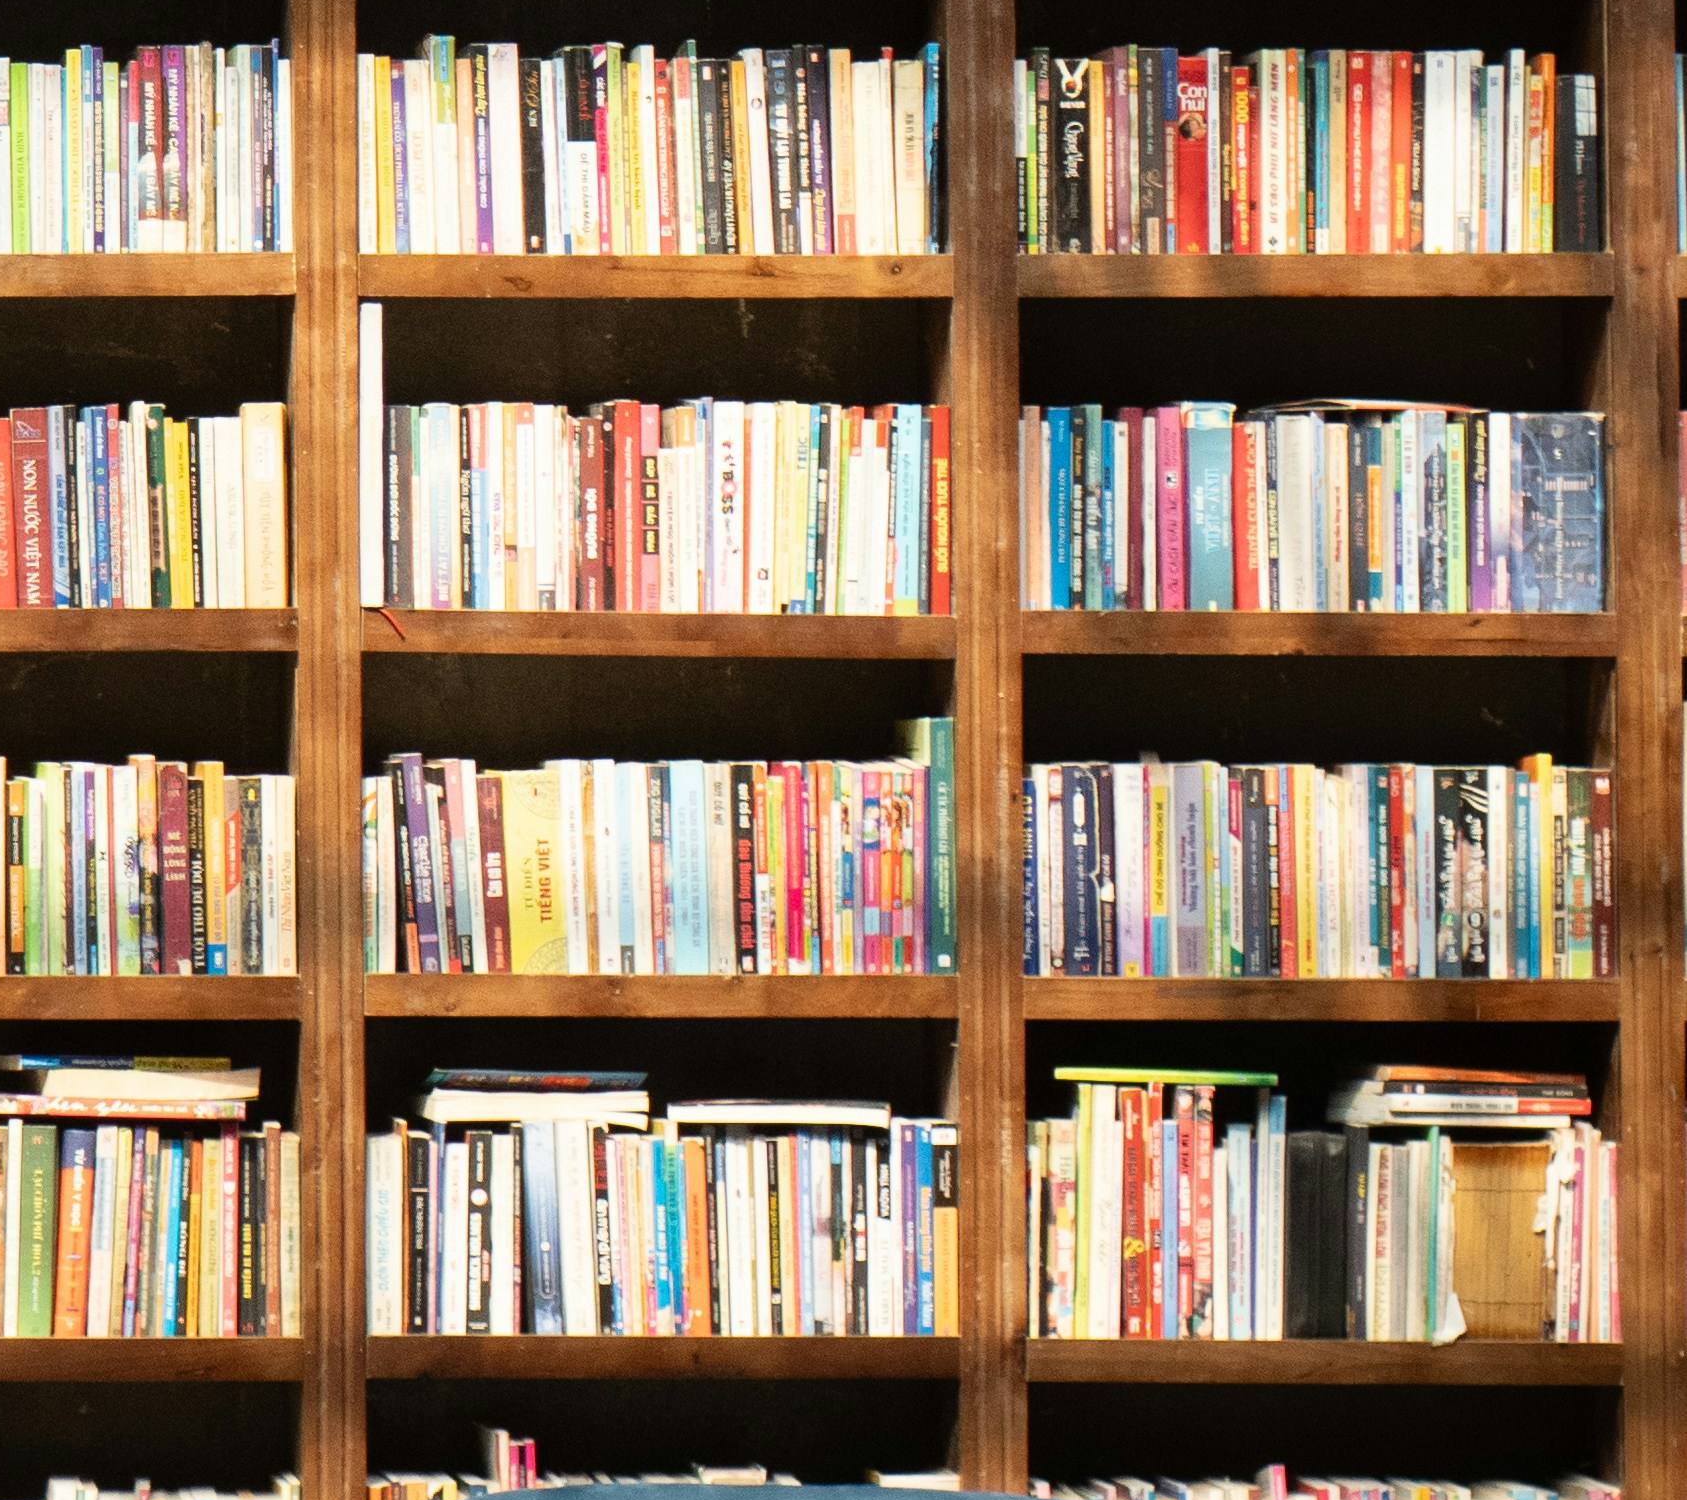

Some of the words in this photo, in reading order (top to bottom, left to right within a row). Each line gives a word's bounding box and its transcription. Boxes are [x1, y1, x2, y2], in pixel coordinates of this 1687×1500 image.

[1177, 82, 1207, 98] Con
[22, 460, 37, 491] NON
[934, 458, 947, 481] TRẺ
[23, 494, 40, 534] NƯỚC
[934, 510, 949, 547] NGUỒN
[24, 538, 40, 569] VIỆT
[935, 548, 949, 573] SUỐI
[25, 572, 41, 605] NAM
[651, 777, 660, 793] ZIG
[651, 795, 661, 838] ZIGLAR
[535, 838, 553, 872] VIỆT
[535, 877, 554, 923] TIẾNG
